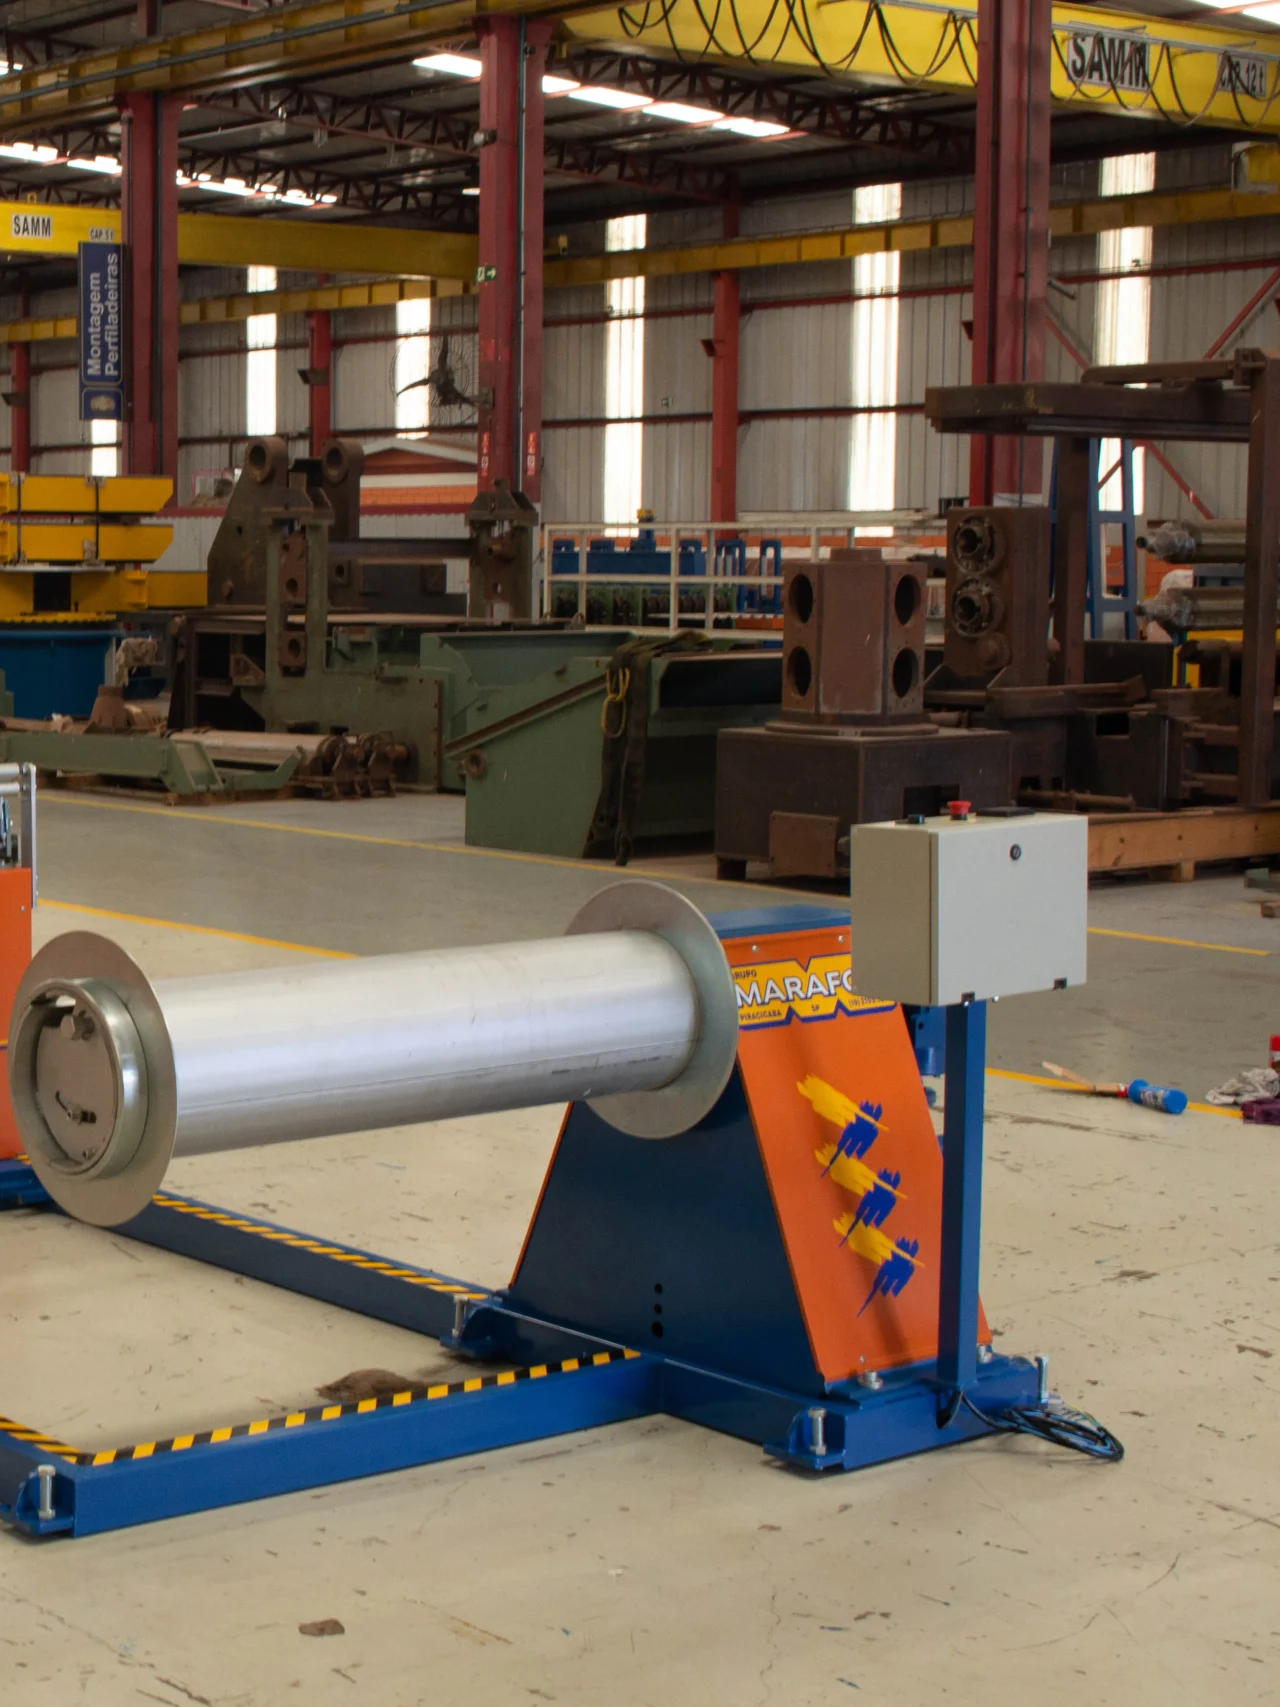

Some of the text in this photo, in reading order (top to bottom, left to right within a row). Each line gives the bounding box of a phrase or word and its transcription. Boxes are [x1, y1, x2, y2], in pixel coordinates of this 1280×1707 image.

[1071, 35, 1149, 89] SAMM
[13, 215, 51, 237] SAMM
[87, 271, 104, 376] Montagem
[104, 252, 119, 376] Perfiladeiras
[734, 969, 852, 1008] MARAF
